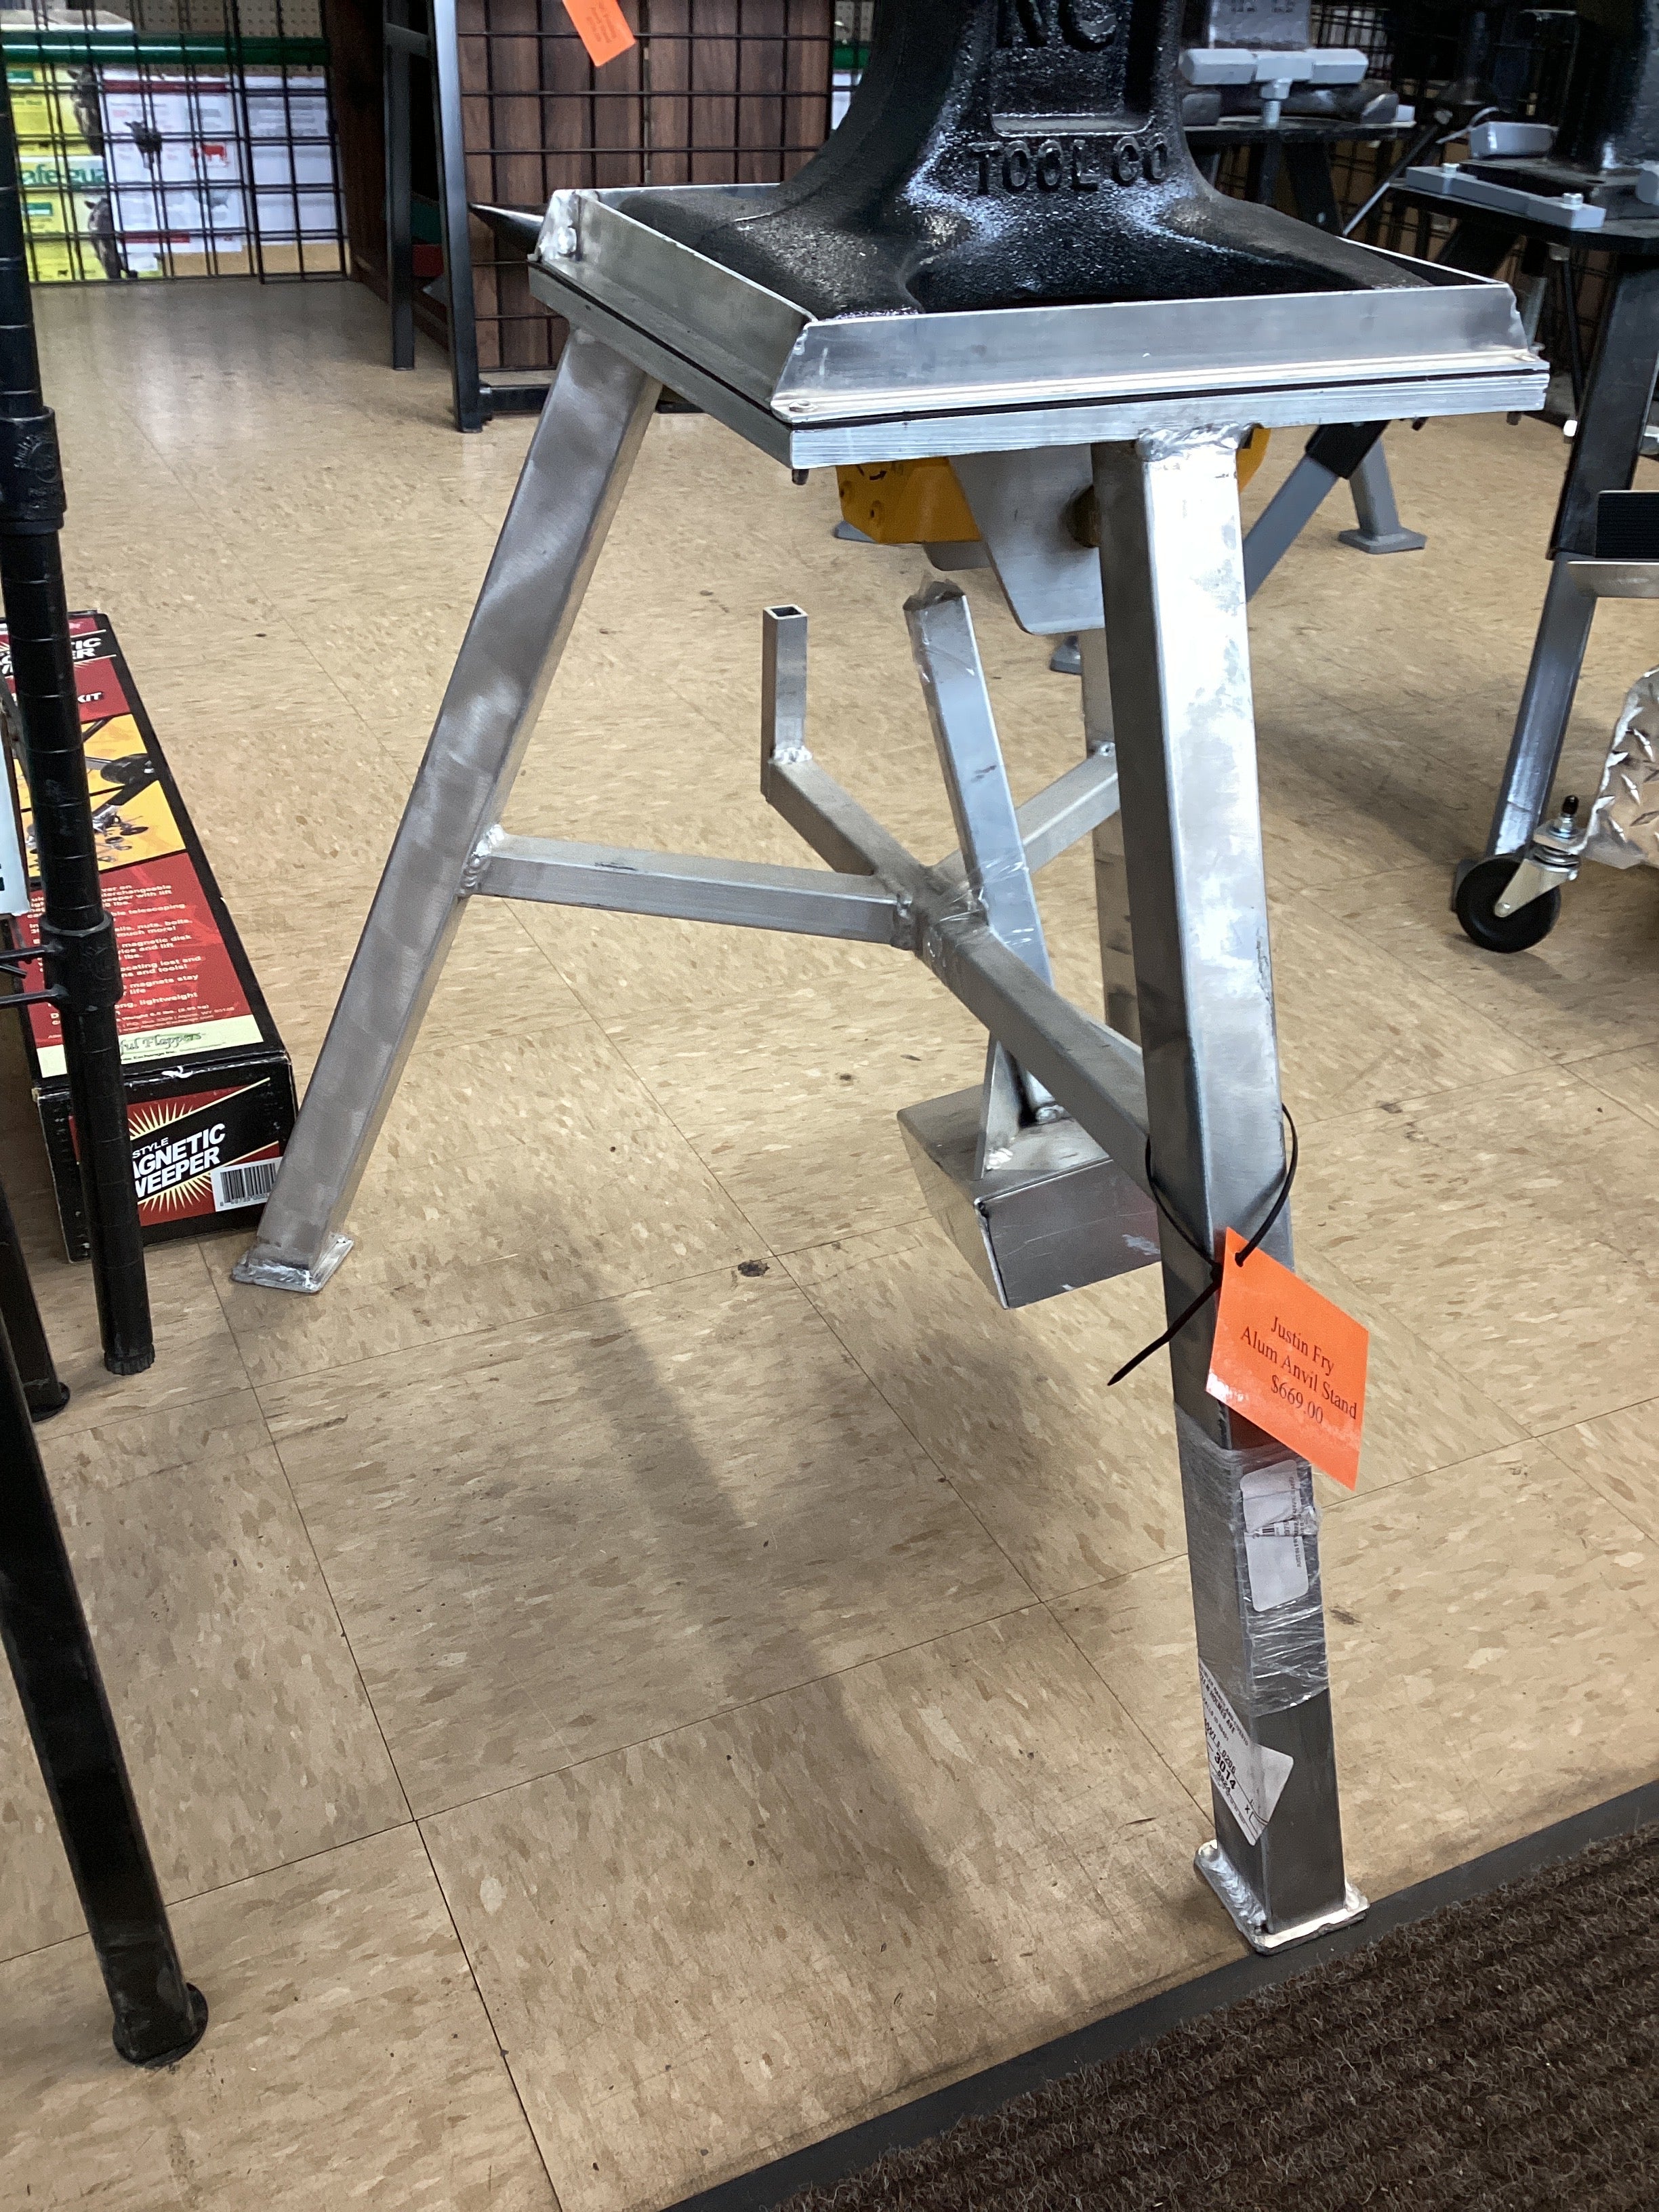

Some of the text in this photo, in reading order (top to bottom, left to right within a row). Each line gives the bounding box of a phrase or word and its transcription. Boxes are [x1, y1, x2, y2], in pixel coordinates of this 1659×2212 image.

[968, 139, 1101, 195] TOOL
[128, 903, 186, 915] telescoping
[117, 929, 146, 937] much
[121, 934, 192, 948] magnetic disk
[138, 944, 159, 952] and
[120, 955, 202, 972] ocating lost and
[136, 968, 157, 976] and
[129, 974, 199, 989] magnets stay
[139, 991, 199, 1006] lightweight
[142, 1032, 202, 1050] Flappers
[132, 1136, 169, 1159] STYLE
[133, 1123, 226, 1179] GNETIC
[1271, 1315, 1334, 1376] Justin Fry
[1240, 1326, 1357, 1420] Alum Anvil Stand
[1271, 1374, 1324, 1424] $669.00
[1214, 1751, 1236, 1790] 3014
